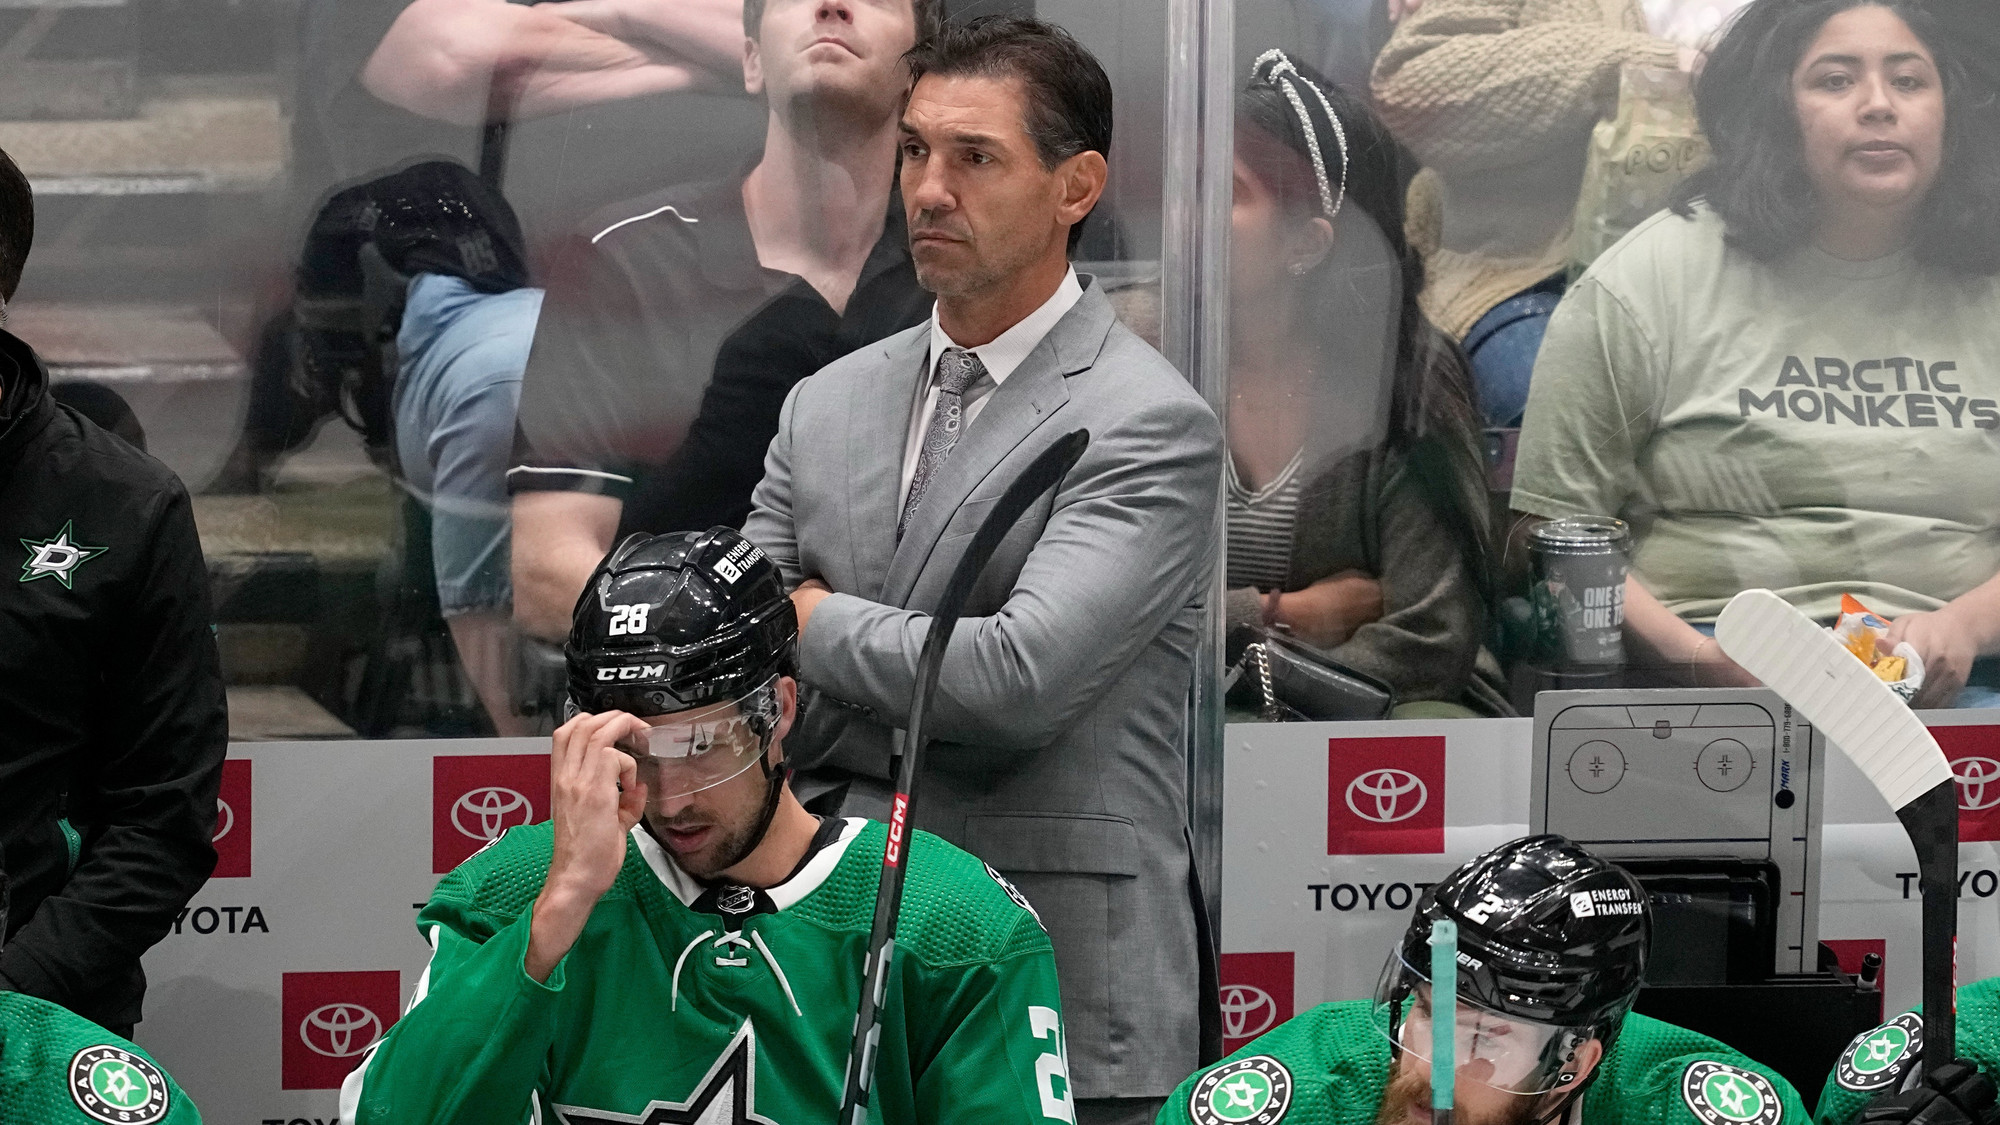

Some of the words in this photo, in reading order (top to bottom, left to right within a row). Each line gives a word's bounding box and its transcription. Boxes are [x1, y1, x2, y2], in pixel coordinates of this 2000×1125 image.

[1775, 355, 1961, 394] ARCTIC
[1738, 388, 2000, 430] MONKEYS
[1583, 587, 1613, 608] ONE
[609, 603, 651, 636] 28
[1583, 606, 1611, 629] ONE
[597, 664, 666, 681] CCM
[1780, 759, 1790, 791] MARK
[887, 797, 907, 863] CCM
[1463, 893, 1504, 925] 2
[1591, 888, 1631, 902] ENERGY
[1595, 902, 1643, 916] TRANSFER
[76, 1050, 131, 1107] DALLAS
[1239, 1061, 1285, 1124] DALLAS
[1690, 1065, 1734, 1121] DALLAS
[118, 1074, 163, 1121] STARS
[1197, 1076, 1234, 1125] STAR
